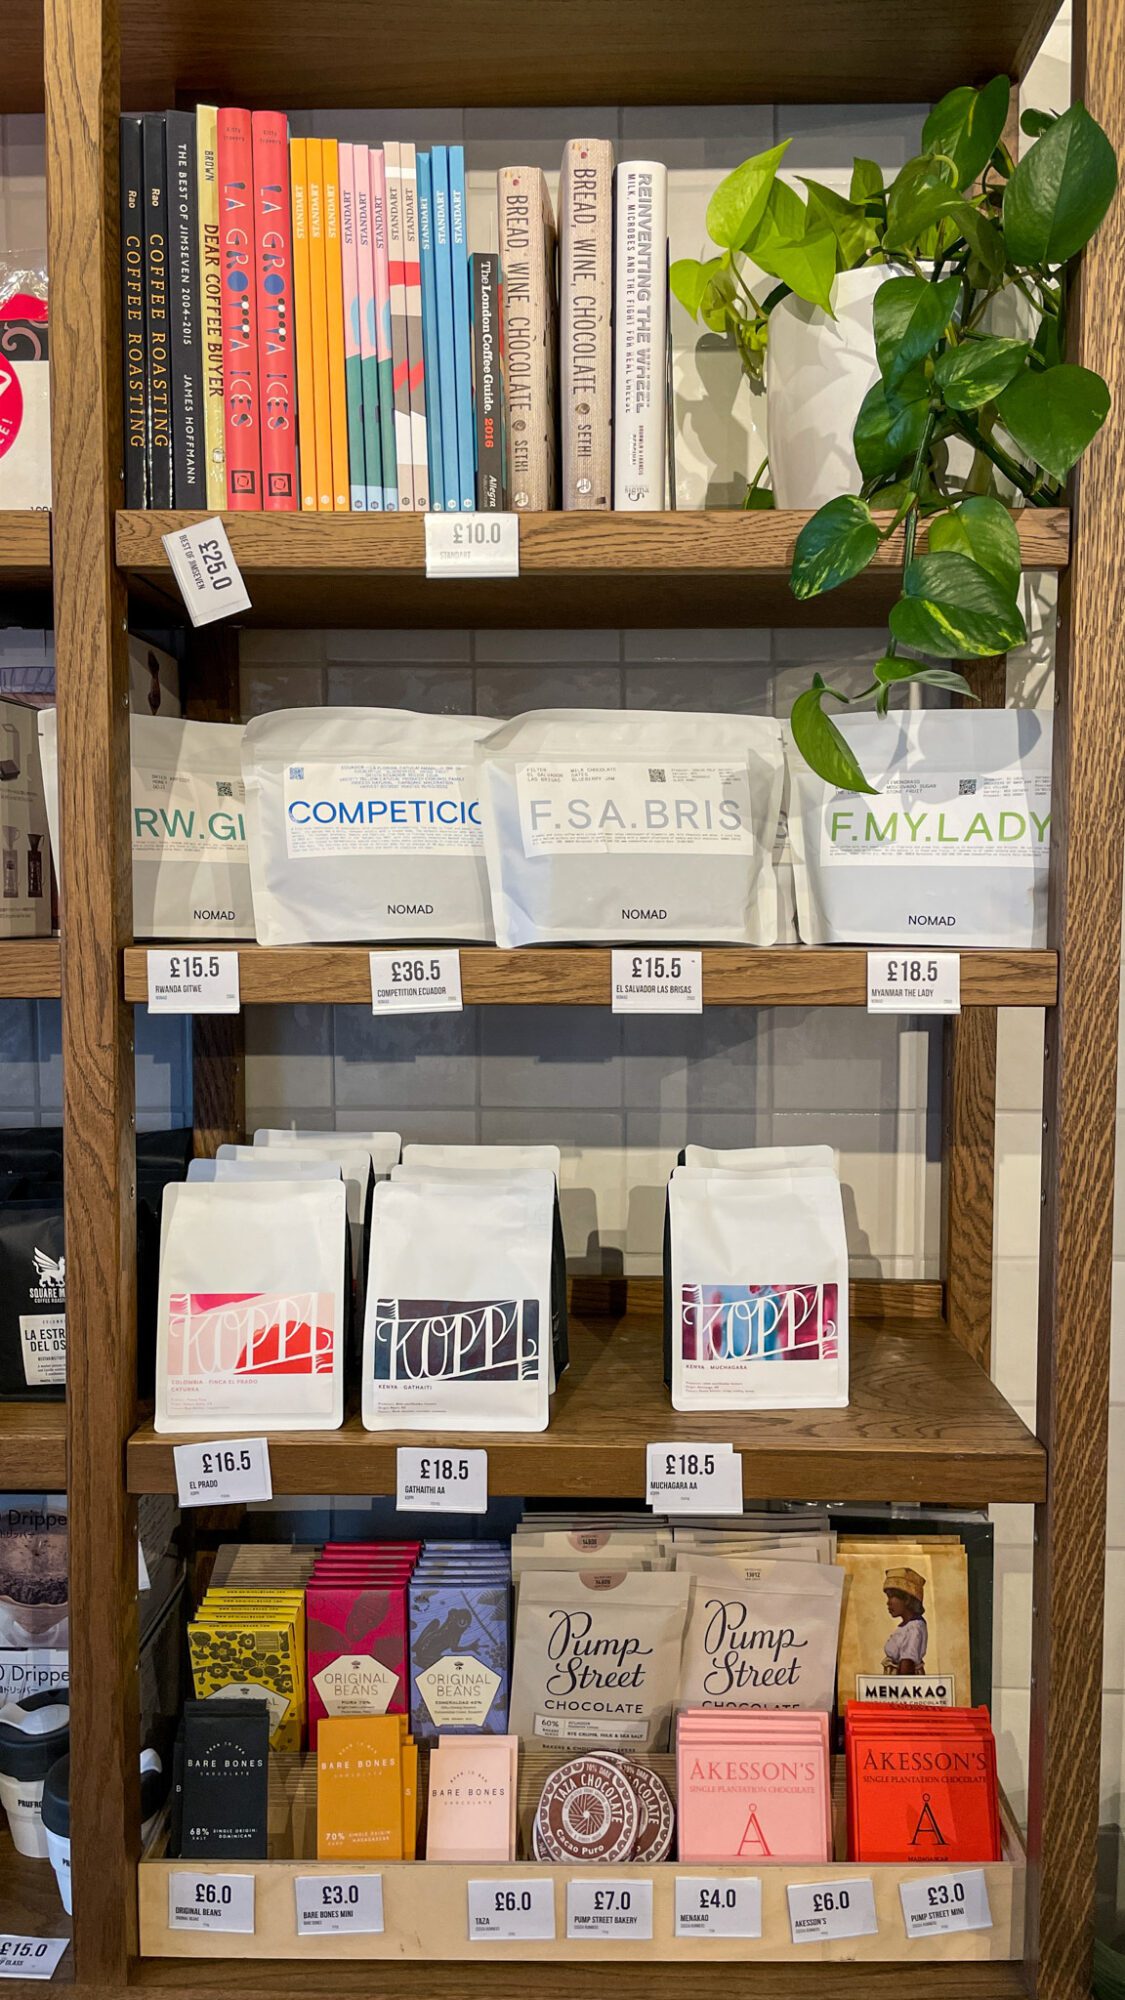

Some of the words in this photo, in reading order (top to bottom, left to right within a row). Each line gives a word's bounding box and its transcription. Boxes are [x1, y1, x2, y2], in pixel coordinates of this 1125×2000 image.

[178, 144, 187, 166] THE
[204, 150, 214, 182] BROWN
[152, 188, 161, 207] Rao
[178, 172, 188, 200] BEST
[224, 182, 246, 212] LA
[571, 168, 597, 228] BREAD,
[128, 190, 137, 209] Rao
[260, 185, 283, 214] LA
[311, 184, 320, 238] STANDART
[327, 184, 336, 238] STANDART
[180, 206, 188, 220] OF
[296, 185, 304, 239] STANDART
[343, 191, 352, 244] STANDART
[359, 192, 368, 245] STANDART
[375, 196, 384, 248] STANDART
[390, 187, 399, 240] STANDART
[406, 188, 415, 241] STANDART
[420, 197, 429, 249] STANDART
[437, 191, 446, 244] STANDART
[453, 190, 462, 243] STANDART
[504, 195, 529, 252] BREAD,
[627, 204, 636, 250] MICROBES
[638, 174, 653, 303] REINVENTING
[180, 224, 191, 284] JIMSEVEN
[204, 224, 220, 266] DEAR
[480, 261, 492, 286] The
[571, 238, 597, 286] WINE,
[626, 256, 636, 274] AND
[126, 236, 142, 320] COFFEE
[150, 234, 165, 319] COFFEE
[506, 262, 530, 308] WINE,
[626, 279, 635, 295] THE
[225, 228, 250, 352] GROTTA
[262, 231, 287, 356] GROTTA
[182, 288, 192, 345] 2004-2015
[205, 274, 223, 337] COFFEE
[481, 286, 493, 331] London
[626, 299, 635, 326] FIGHT
[637, 306, 651, 343] THE
[482, 332, 494, 373] Coffee
[572, 296, 596, 396] CHOCOLATE
[207, 343, 224, 397] BUYER
[507, 316, 531, 412] CHOCOLATE
[128, 333, 145, 447] ROASTING
[152, 332, 168, 446] ROASTING
[184, 374, 194, 411] JAMES
[230, 370, 253, 428] ICES
[482, 374, 494, 414] Guide.
[266, 373, 290, 430] ICES
[484, 418, 494, 448] 2016
[578, 424, 592, 458] SETHI
[185, 416, 196, 484] HOFFMANN
[514, 440, 528, 473] SETHI
[488, 475, 499, 508] Allegra
[179, 534, 192, 550] BEST
[453, 522, 500, 544] £10.0
[185, 551, 194, 560] OF
[198, 540, 232, 590] £25.0
[188, 560, 206, 590] JIMSEVEN
[134, 808, 246, 840] RW.GI
[530, 799, 742, 830] F.SA.BRIS
[831, 811, 1052, 842] F.MY.LADY
[193, 910, 236, 921] NOMAD
[387, 904, 434, 916] NOMAD
[622, 909, 668, 920] NOMAD
[908, 915, 956, 926] NOMAD
[170, 956, 220, 978] £15.5
[392, 960, 440, 982] £36.5
[632, 957, 682, 978] £15.5
[888, 960, 938, 982] £18.5
[155, 985, 182, 993] RWANDA
[183, 984, 202, 992] GITWE
[378, 988, 418, 997] COMPETITION
[418, 986, 446, 996] ECUADOR
[616, 984, 624, 992] EL
[625, 984, 656, 992] SALVADOR
[670, 986, 692, 994] BRISAS
[872, 988, 902, 996] MYANMAR
[904, 988, 916, 996] THE
[918, 989, 934, 997] LADY
[30, 1288, 58, 1299] SQUARE
[25, 1330, 37, 1340] LA
[40, 1328, 66, 1340] ESTR
[169, 1293, 333, 1375] KOPPI
[682, 1284, 838, 1360] KOPPI
[30, 1341, 50, 1352] DEL
[374, 1299, 539, 1380] KOPPI
[202, 1450, 251, 1474] £16.5
[420, 1459, 468, 1480] £18.5
[666, 1454, 714, 1475] £18.5
[198, 1480, 218, 1488] PRADO
[404, 1486, 436, 1494] GATHAITHI
[437, 1486, 445, 1494] AA
[650, 1482, 688, 1490] MUCHAGARA
[689, 1482, 698, 1490] AA
[8, 1510, 68, 1529] Drippe
[548, 1610, 654, 1667] Pump
[704, 1600, 808, 1662] Pump
[12, 1666, 70, 1686] Drippe
[324, 1673, 389, 1686] ORIGINAL
[426, 1674, 491, 1686] ORIGINAL
[546, 1657, 646, 1696] Street
[704, 1650, 802, 1696] Street
[334, 1685, 379, 1696] BEANS
[437, 1686, 481, 1697] BEANS
[866, 1686, 946, 1698] MENAKAO
[544, 1700, 644, 1714] CHOCOLATE
[542, 1720, 559, 1728] 60%
[188, 1760, 216, 1768] BARE
[322, 1760, 350, 1770] BARE
[357, 1758, 396, 1768] BONES
[690, 1758, 815, 1780] ÅKESSON'S
[863, 1748, 986, 1772] ÅKESSON'S
[690, 1785, 716, 1793] SINGLE
[718, 1786, 766, 1794] PLANTATION
[768, 1786, 816, 1794] CHOCOLATE
[863, 1775, 889, 1784] SINGLE
[891, 1775, 940, 1784] PLANTATION
[941, 1776, 986, 1784] CHOCOLATE
[432, 1789, 460, 1797] BARE
[468, 1788, 505, 1796] BONES
[554, 1778, 578, 1802] TAZA
[581, 1774, 622, 1823] CHOCOLATE
[190, 1828, 210, 1836] 68%
[325, 1832, 346, 1840] 70%
[556, 1828, 579, 1853] Cacao
[582, 1845, 604, 1855] Puro
[196, 1884, 232, 1904] £6.0
[322, 1885, 358, 1904] £3.0
[495, 1892, 532, 1911] £6.0
[594, 1891, 631, 1910] £7.0
[700, 1888, 736, 1908] £4.0
[813, 1891, 850, 1912] £6.0
[928, 1882, 964, 1906] £3.0
[176, 1906, 201, 1916] ORIGINAL
[202, 1908, 222, 1916] BEANS
[304, 1911, 318, 1919] BARE
[320, 1910, 339, 1918] BONES
[340, 1910, 354, 1918] MINI
[476, 1917, 490, 1925] TAZA
[574, 1916, 590, 1924] PUMP
[592, 1916, 613, 1924] STREET
[614, 1916, 638, 1924] BAKERY
[680, 1914, 709, 1922] MENAKAO
[794, 1918, 827, 1928] AKESSON'S
[910, 1913, 928, 1922] PUMP
[928, 1910, 950, 1920] STREET
[950, 1908, 964, 1916] MINI
[0, 1942, 48, 1957] £15.0
